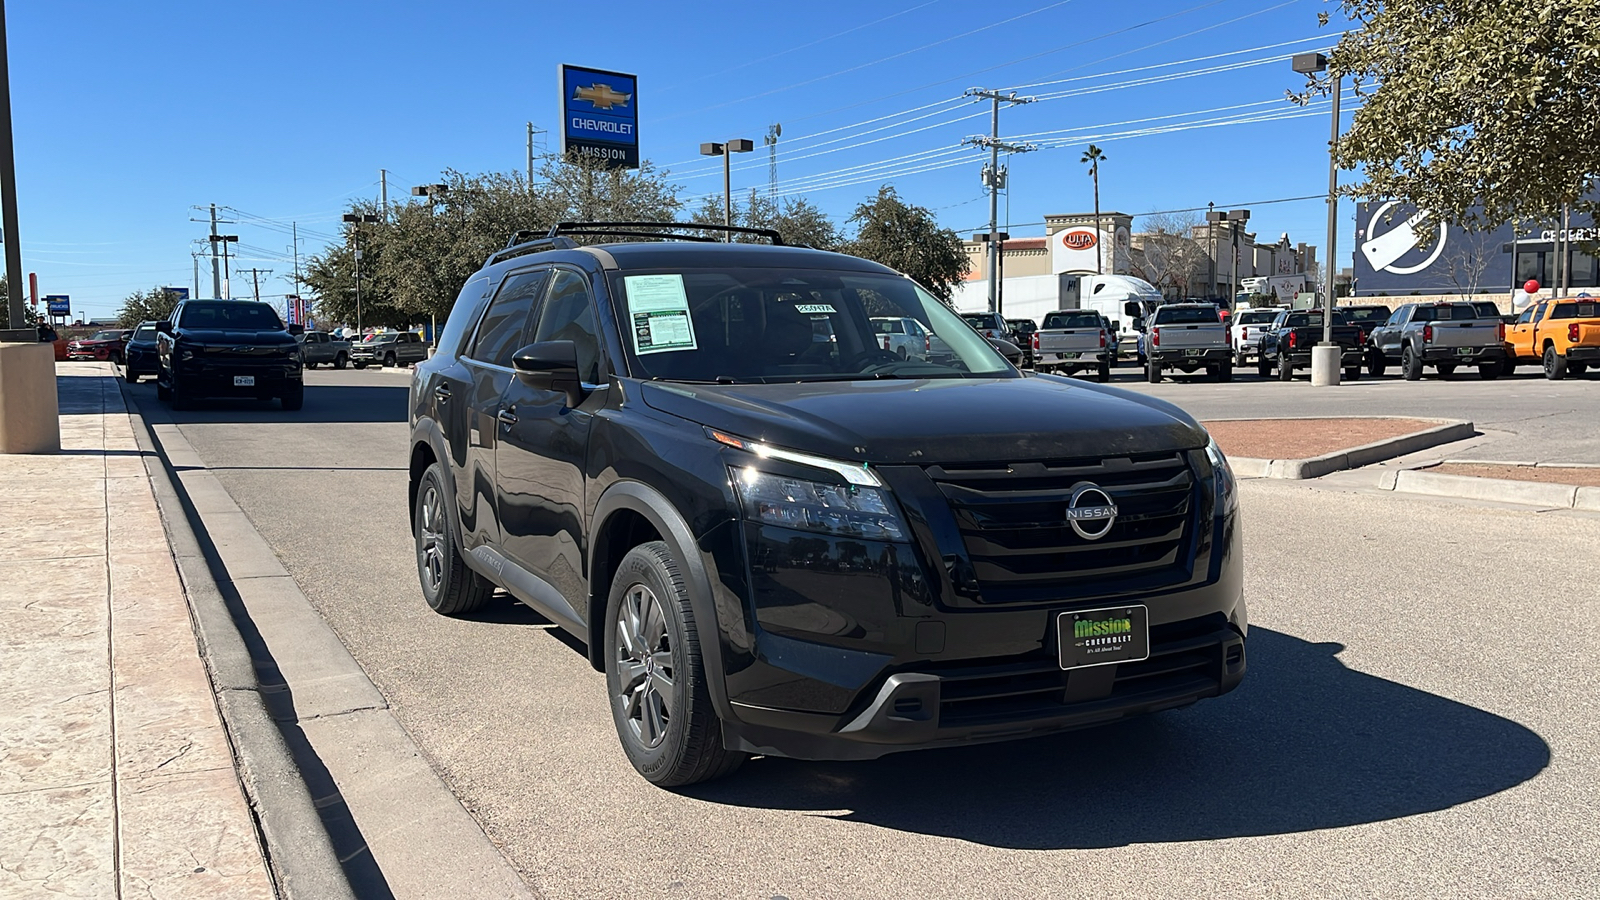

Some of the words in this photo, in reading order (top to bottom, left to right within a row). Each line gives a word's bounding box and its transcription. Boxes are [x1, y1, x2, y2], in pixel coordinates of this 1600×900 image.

[572, 117, 633, 135] CHEVROLET
[581, 145, 626, 160] MISSION
[1066, 234, 1094, 247] ULTA
[1067, 506, 1117, 518] NISSAN
[1074, 617, 1131, 638] Mission
[1085, 635, 1132, 646] CHEVROLET
